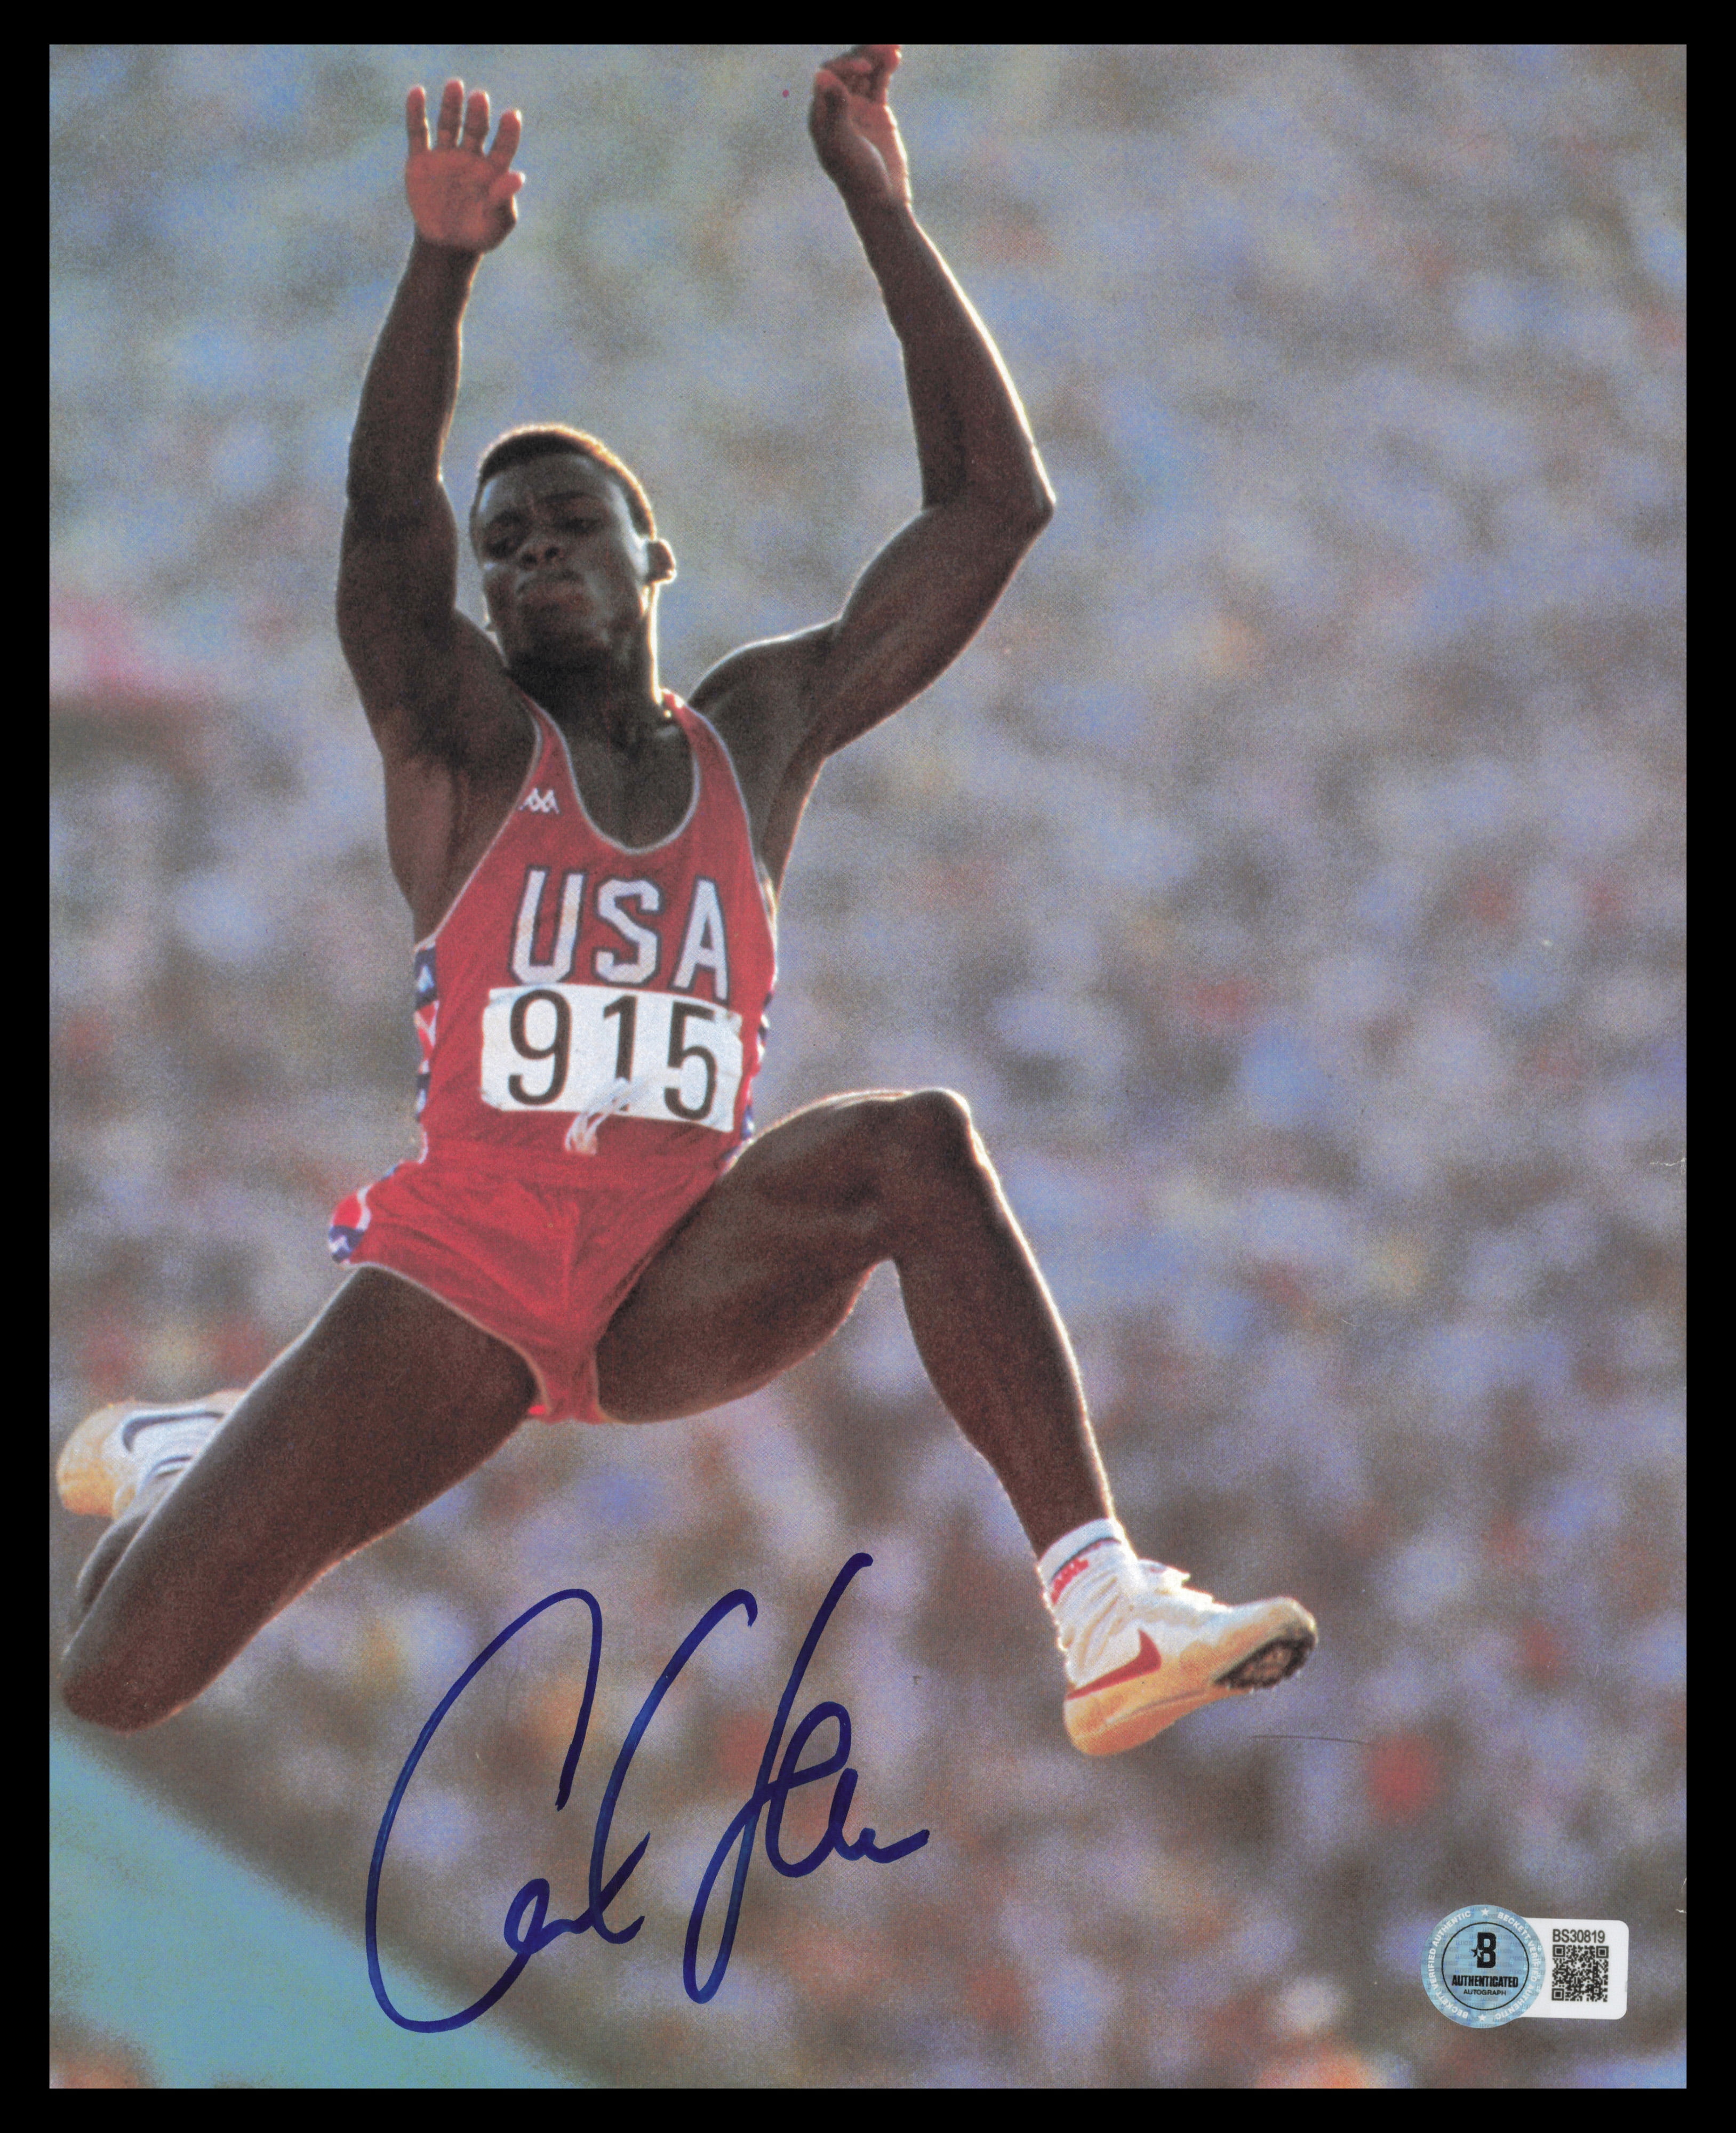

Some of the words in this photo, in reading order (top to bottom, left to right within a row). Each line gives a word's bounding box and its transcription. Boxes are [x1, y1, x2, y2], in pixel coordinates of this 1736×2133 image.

[509, 867, 731, 1004] USA
[508, 989, 718, 1120] 915
[1432, 1910, 1471, 1947] AUTHENTIC
[1497, 1912, 1531, 1941] BECKETT
[1553, 1929, 1605, 1944] BS30819
[1427, 1948, 1439, 1990] VERIFIED
[1527, 1940, 1540, 1982] VERIFIED
[1451, 1975, 1518, 1988] AUTHENTICATED
[1435, 1991, 1468, 2019] BECKETT
[1494, 1984, 1534, 2020] AUTHENTIC
